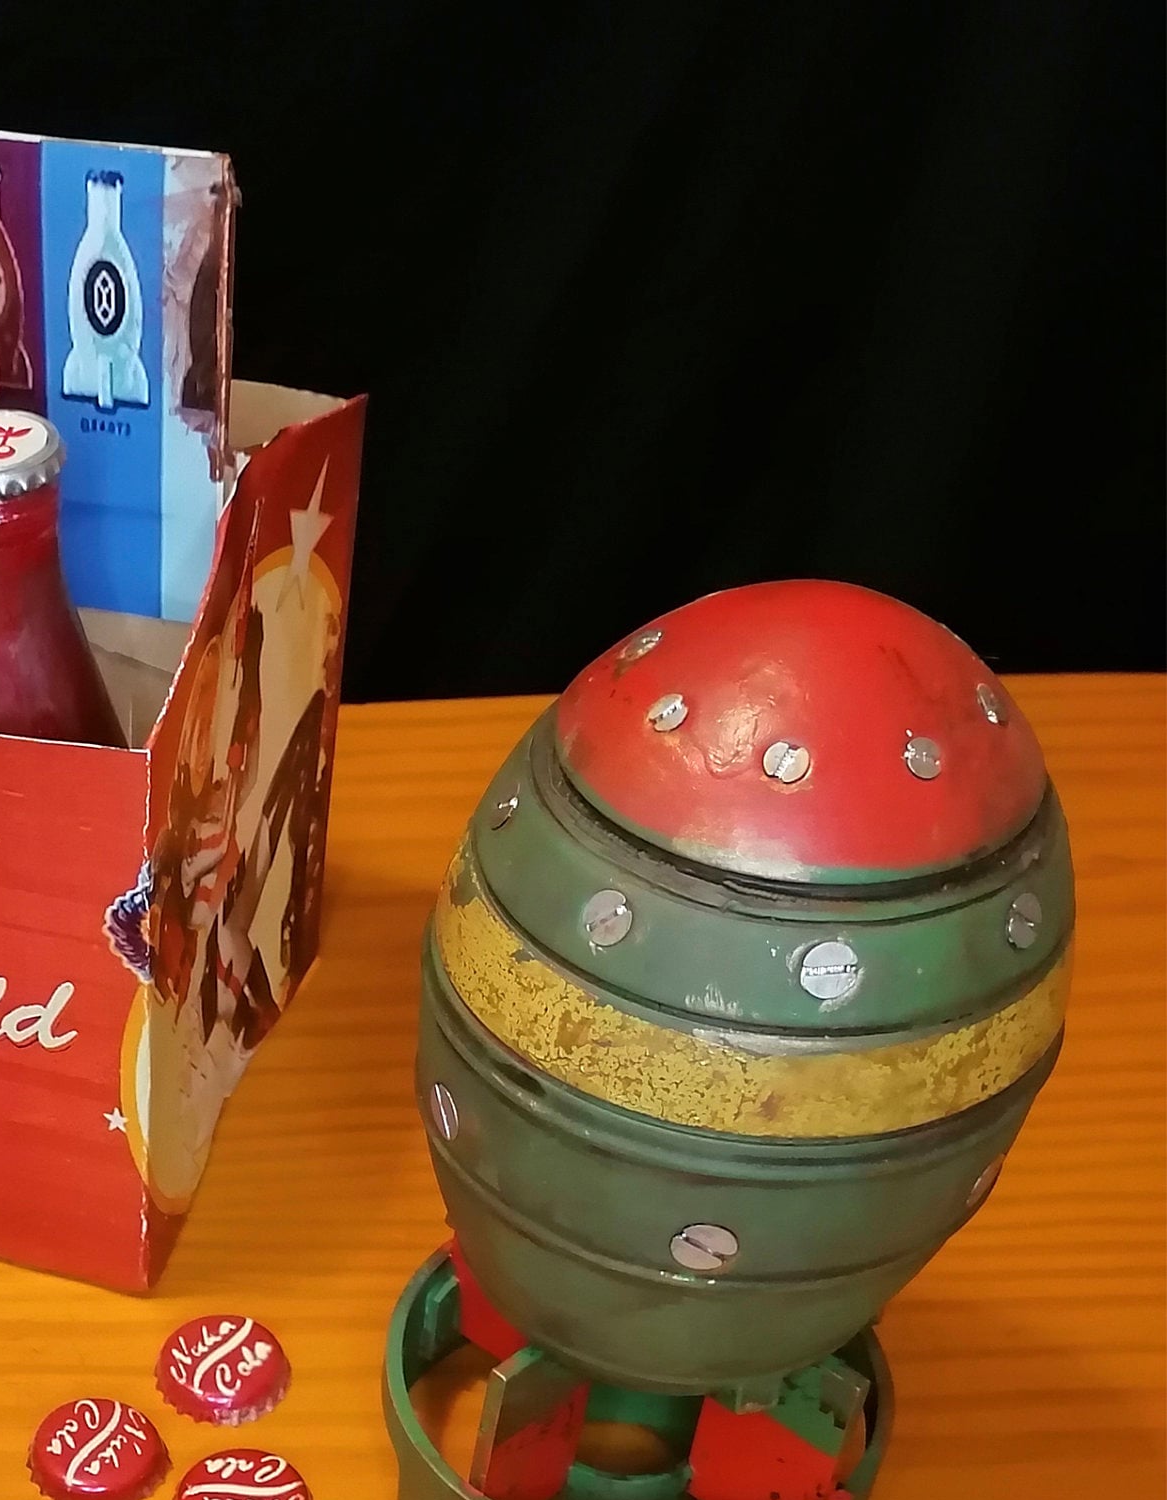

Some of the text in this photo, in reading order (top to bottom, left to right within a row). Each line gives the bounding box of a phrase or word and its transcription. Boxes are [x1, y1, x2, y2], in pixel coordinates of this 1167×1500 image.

[170, 1321, 236, 1384] Nuka
[46, 1400, 100, 1455] Cola
[84, 1408, 147, 1475] Nuka
